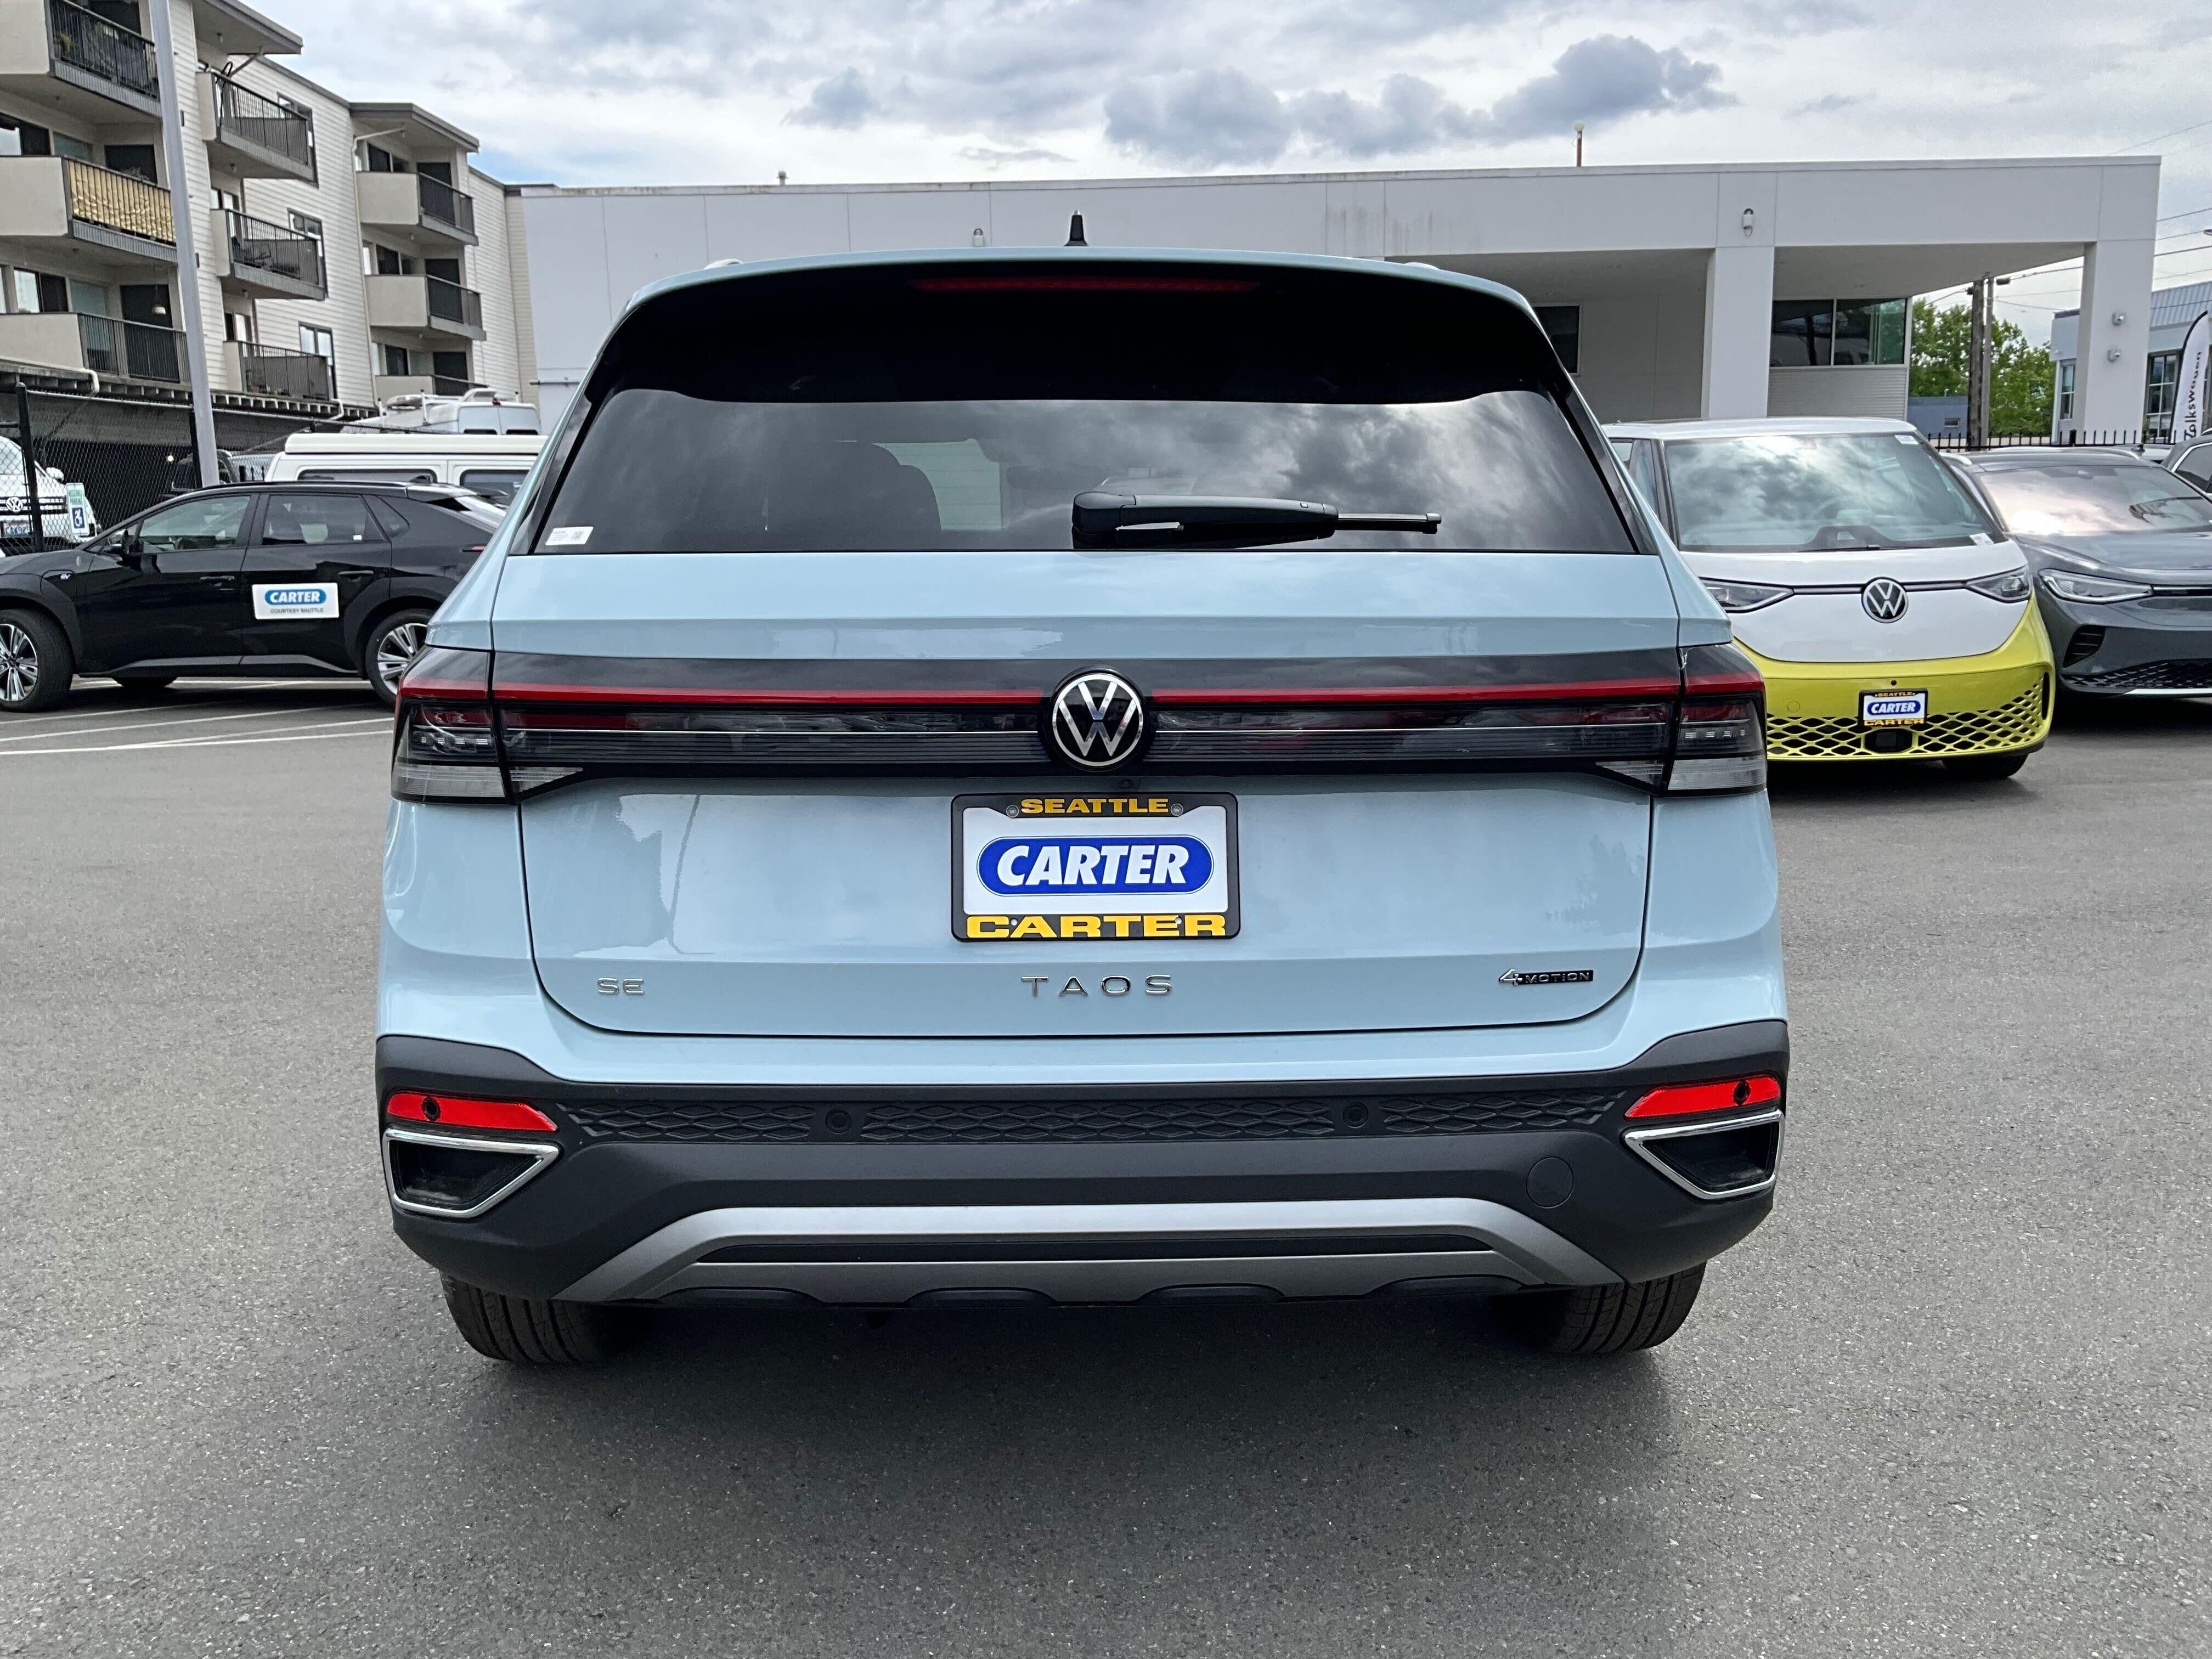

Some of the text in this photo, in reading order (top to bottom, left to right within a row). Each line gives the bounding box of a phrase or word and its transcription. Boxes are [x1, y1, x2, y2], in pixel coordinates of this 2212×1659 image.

[270, 591, 320, 603] CARTER
[1864, 580, 1906, 620] VW
[1056, 677, 1140, 761] VW
[1871, 702, 1916, 714] CARTER
[1020, 798, 1169, 814] SEATTLE
[997, 845, 1189, 887] CARTER
[967, 914, 1226, 939] CARTER
[597, 978, 645, 995] SE
[1021, 974, 1172, 997] TAOS
